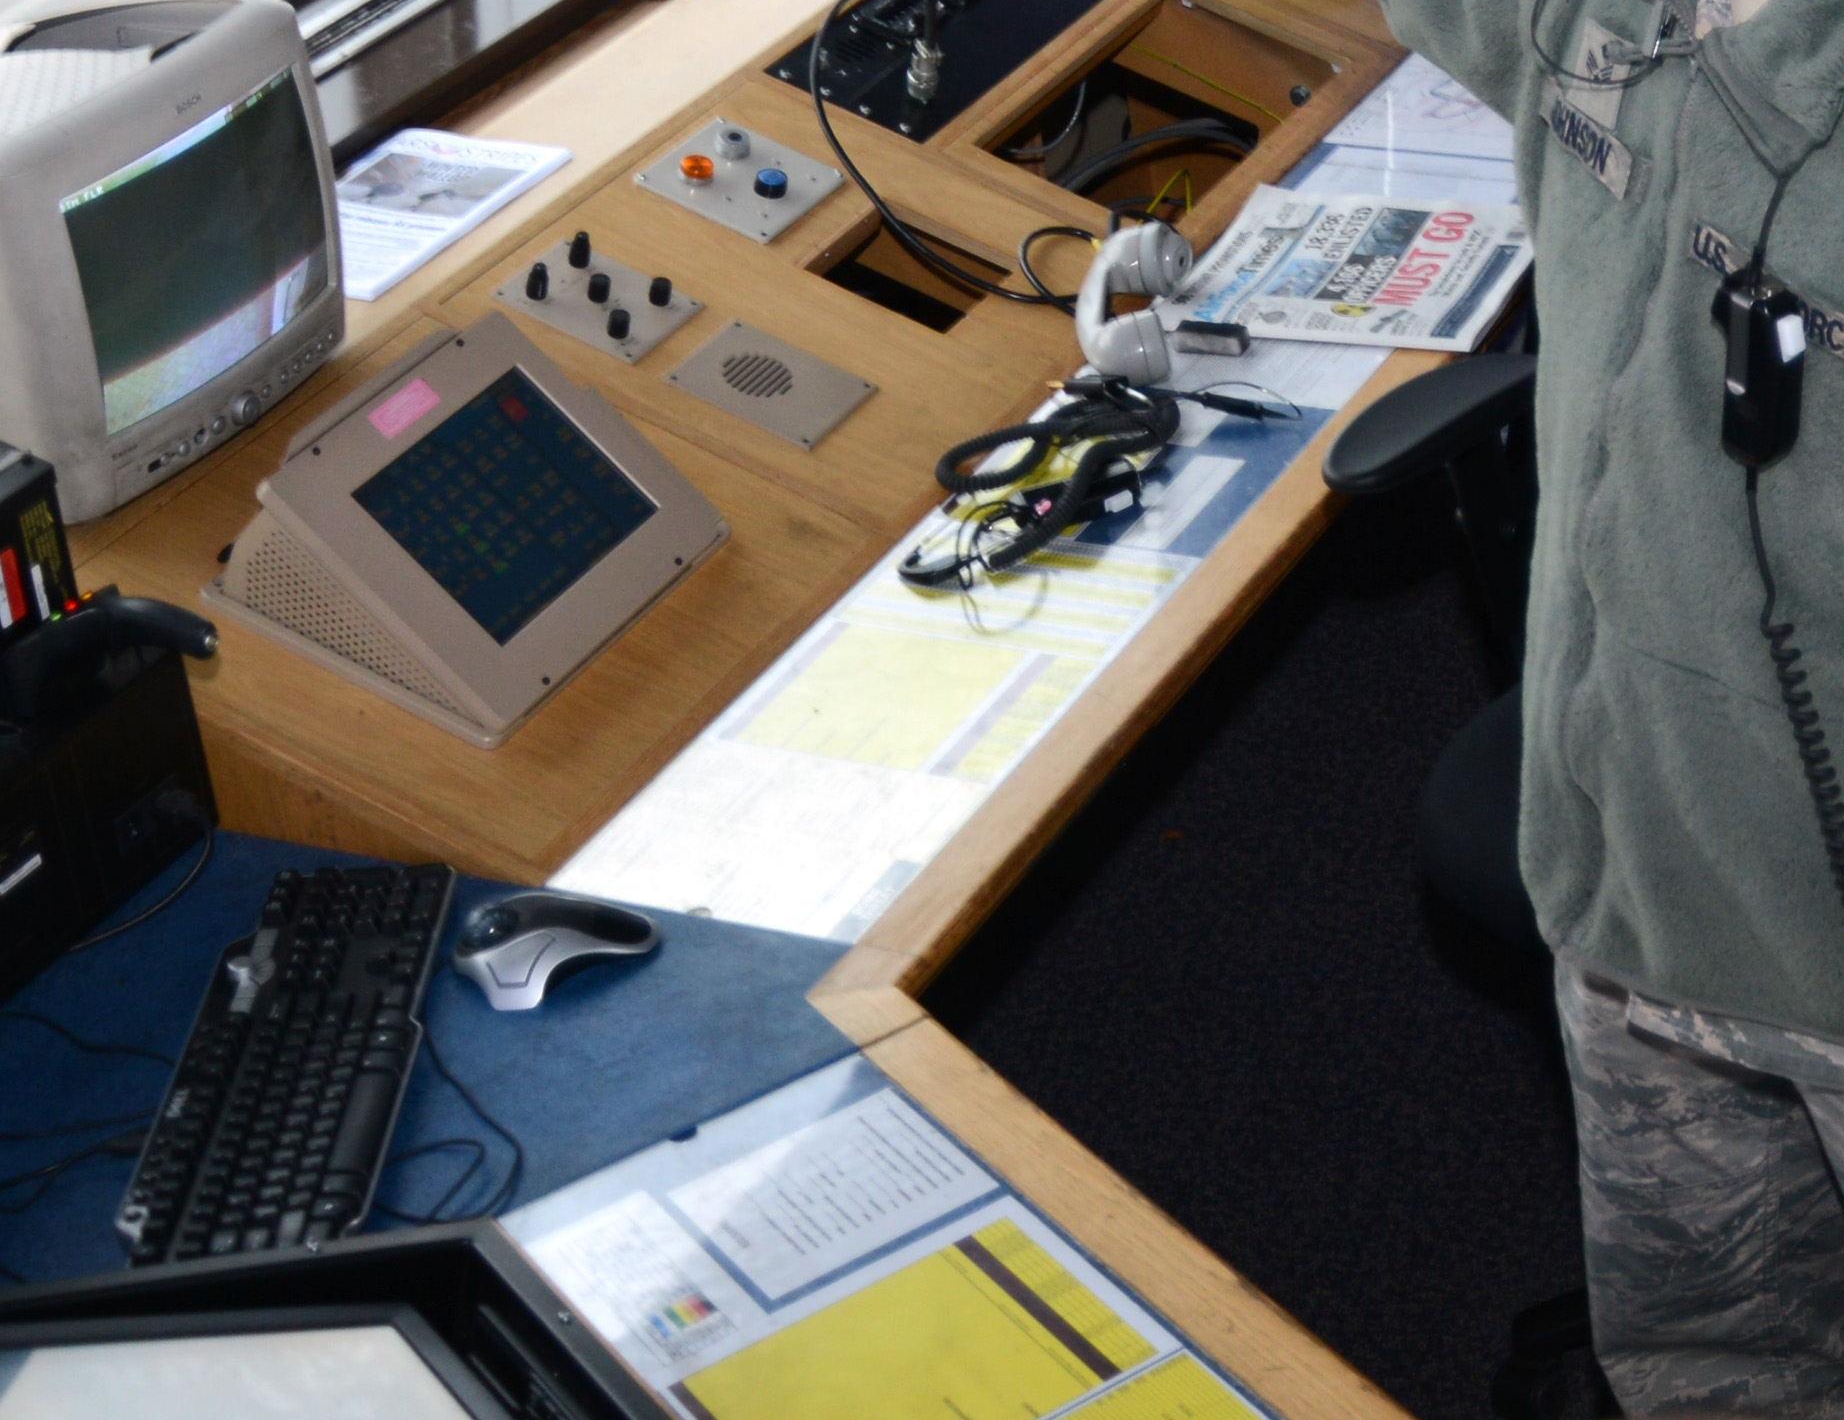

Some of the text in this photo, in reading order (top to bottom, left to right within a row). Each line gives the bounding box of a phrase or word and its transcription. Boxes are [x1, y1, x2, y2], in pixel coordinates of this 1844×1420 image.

[1322, 206, 1374, 262] ENLISTED
[1371, 247, 1451, 307] MUST
[1421, 211, 1475, 243] GO
